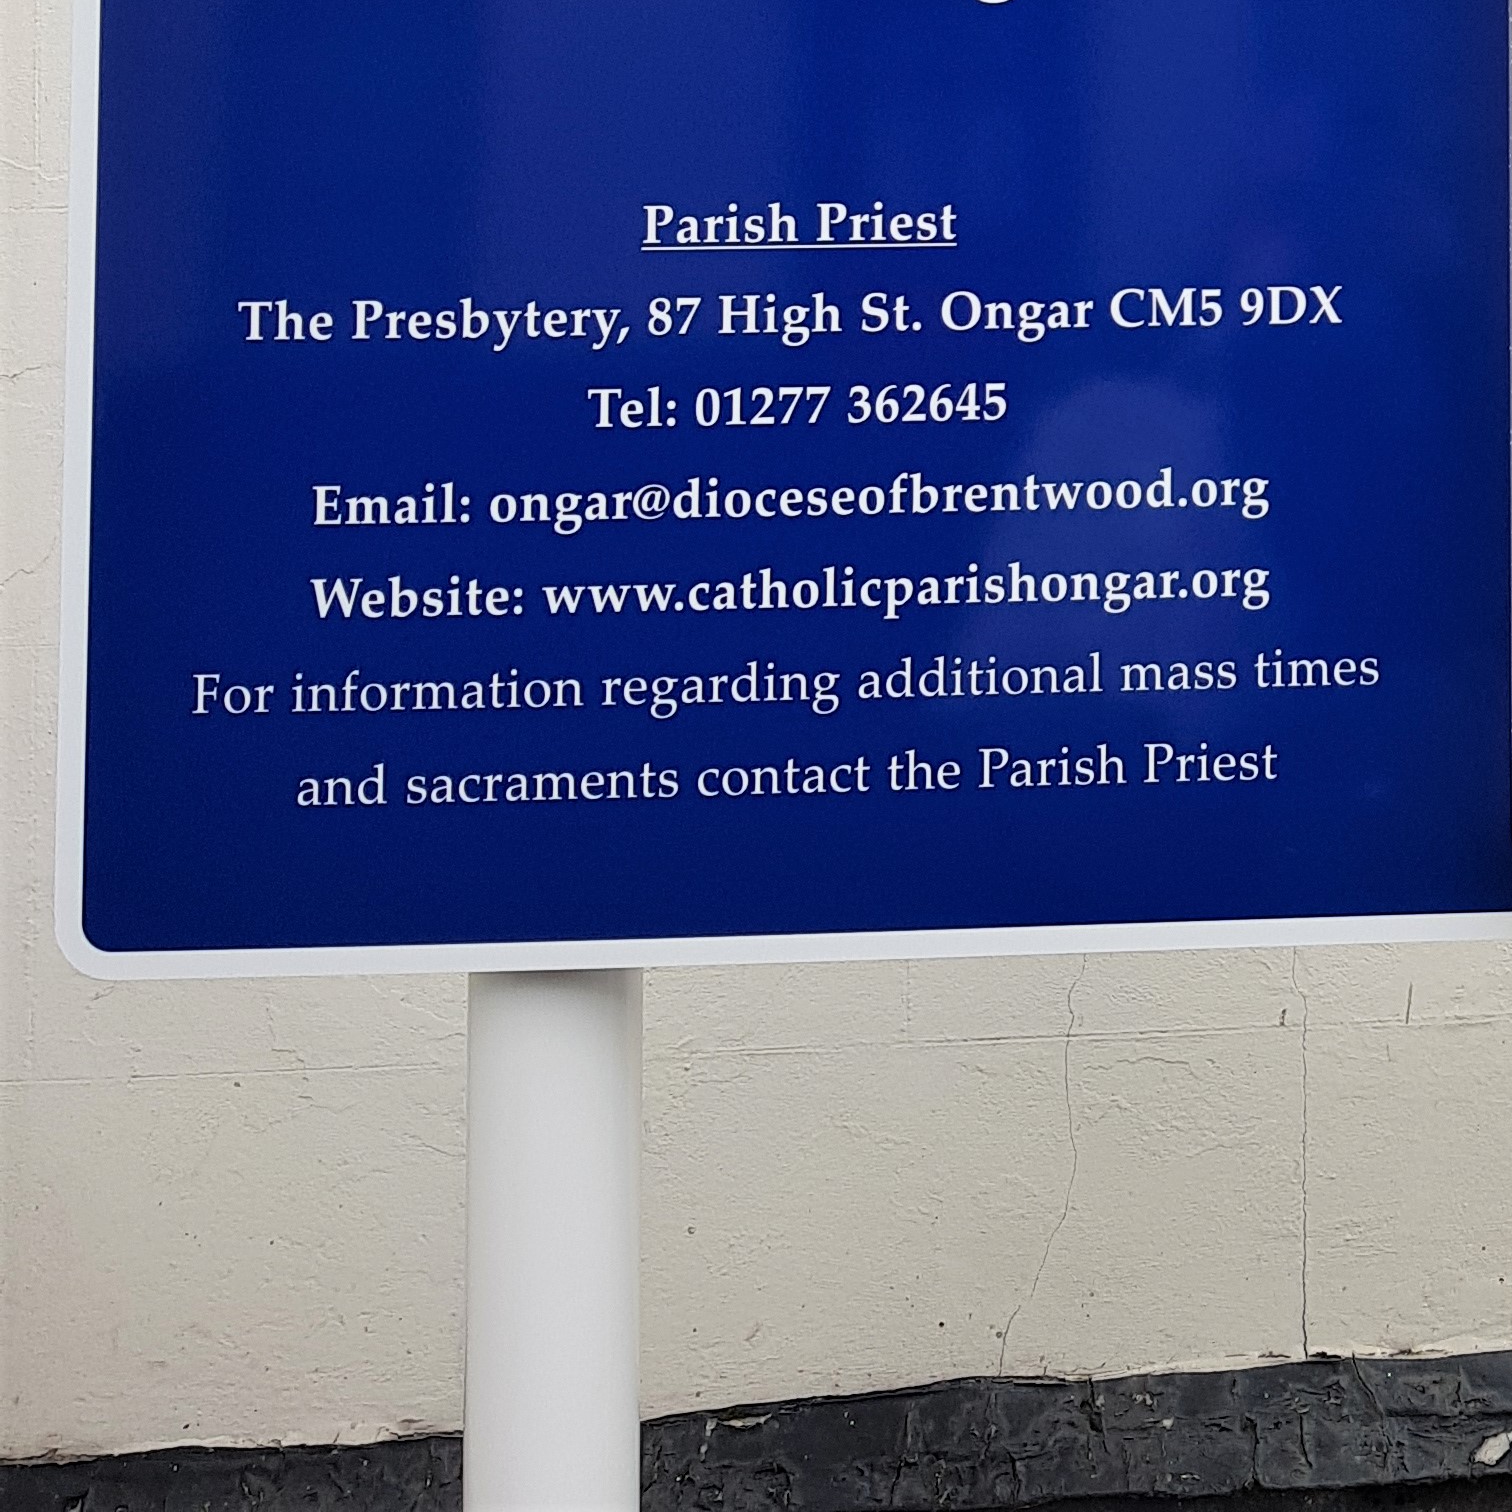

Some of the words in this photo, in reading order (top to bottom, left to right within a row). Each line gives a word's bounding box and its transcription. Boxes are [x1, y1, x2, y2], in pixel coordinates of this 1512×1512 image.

[643, 203, 798, 243] Parish
[817, 202, 956, 241] Priest
[238, 300, 332, 340] The
[352, 298, 629, 351] Presbytery,
[648, 298, 701, 335] 87
[719, 293, 842, 346] High
[862, 293, 921, 332] St.
[942, 291, 1093, 342] Ongar
[1111, 288, 1222, 327] CM5
[1241, 286, 1342, 325] 9DX
[588, 387, 676, 427] Tel:
[696, 387, 830, 426] 01277
[848, 383, 1006, 423] 362645
[313, 482, 469, 524] Email:
[490, 467, 1269, 534] ongar@dioceseofbrentwood.org
[311, 576, 522, 618] Website:
[542, 562, 1269, 619] www.catholicparishongar.org
[193, 675, 273, 713] For
[292, 669, 583, 711] information
[602, 661, 840, 718] regarding
[859, 652, 1102, 698] additional
[1121, 662, 1236, 691] mass
[1255, 649, 1378, 687] times
[298, 764, 386, 805] and
[407, 763, 678, 803] sacraments
[698, 757, 870, 796] contact
[888, 750, 960, 790] the
[979, 744, 1126, 787] Parish
[1144, 743, 1277, 782] Priest
